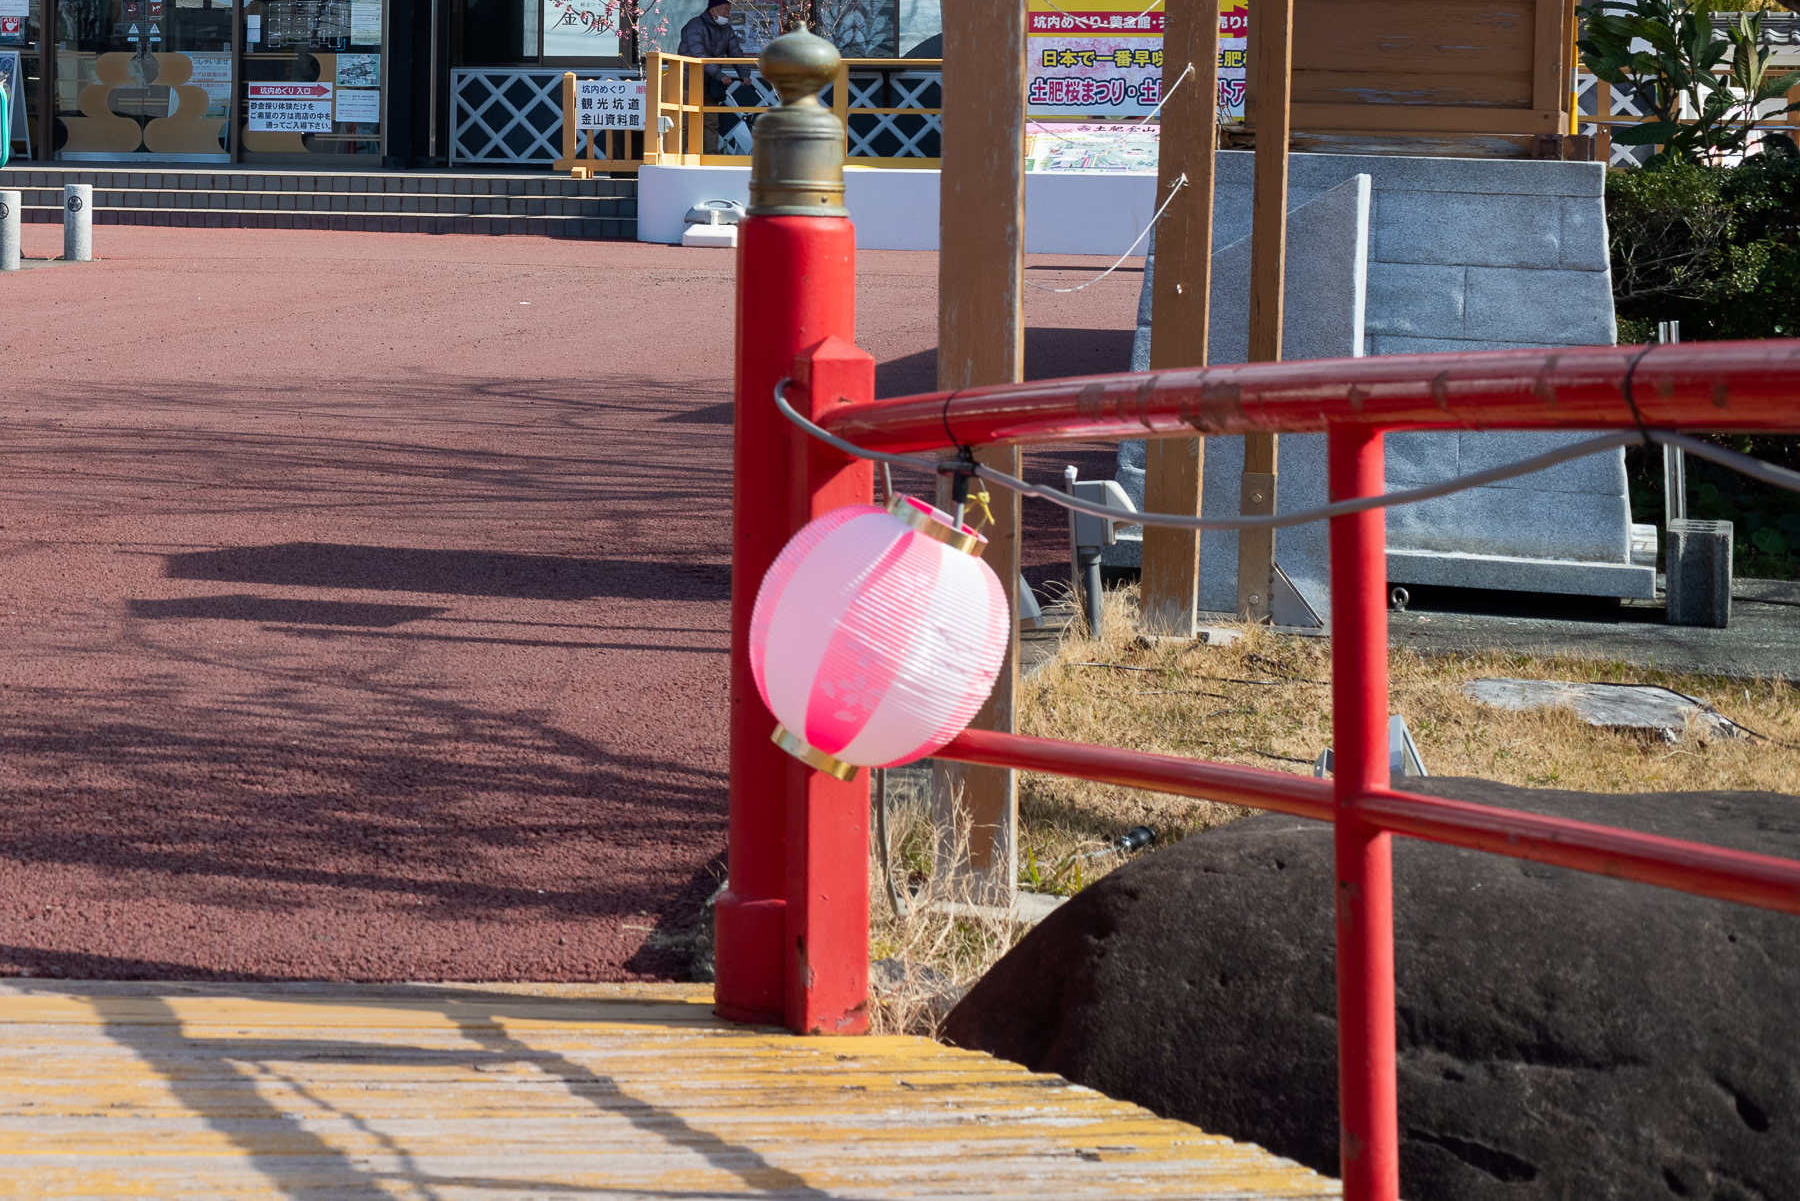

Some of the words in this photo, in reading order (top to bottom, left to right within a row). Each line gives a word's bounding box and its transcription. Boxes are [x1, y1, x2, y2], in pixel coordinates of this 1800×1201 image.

[260, 87, 295, 95] 坑内めぐり
[296, 87, 311, 95] 入口
[581, 85, 626, 94] 坑内めぐり
[250, 101, 315, 110] 砂金採り体験だけを
[581, 97, 640, 110] 観光坑道
[250, 111, 331, 120] ご希望の方は売店の中を
[581, 113, 640, 126] 金山資料館
[265, 121, 331, 130] 通ってご入場下さい。
[1093, 125, 1156, 133] 土肥金山
